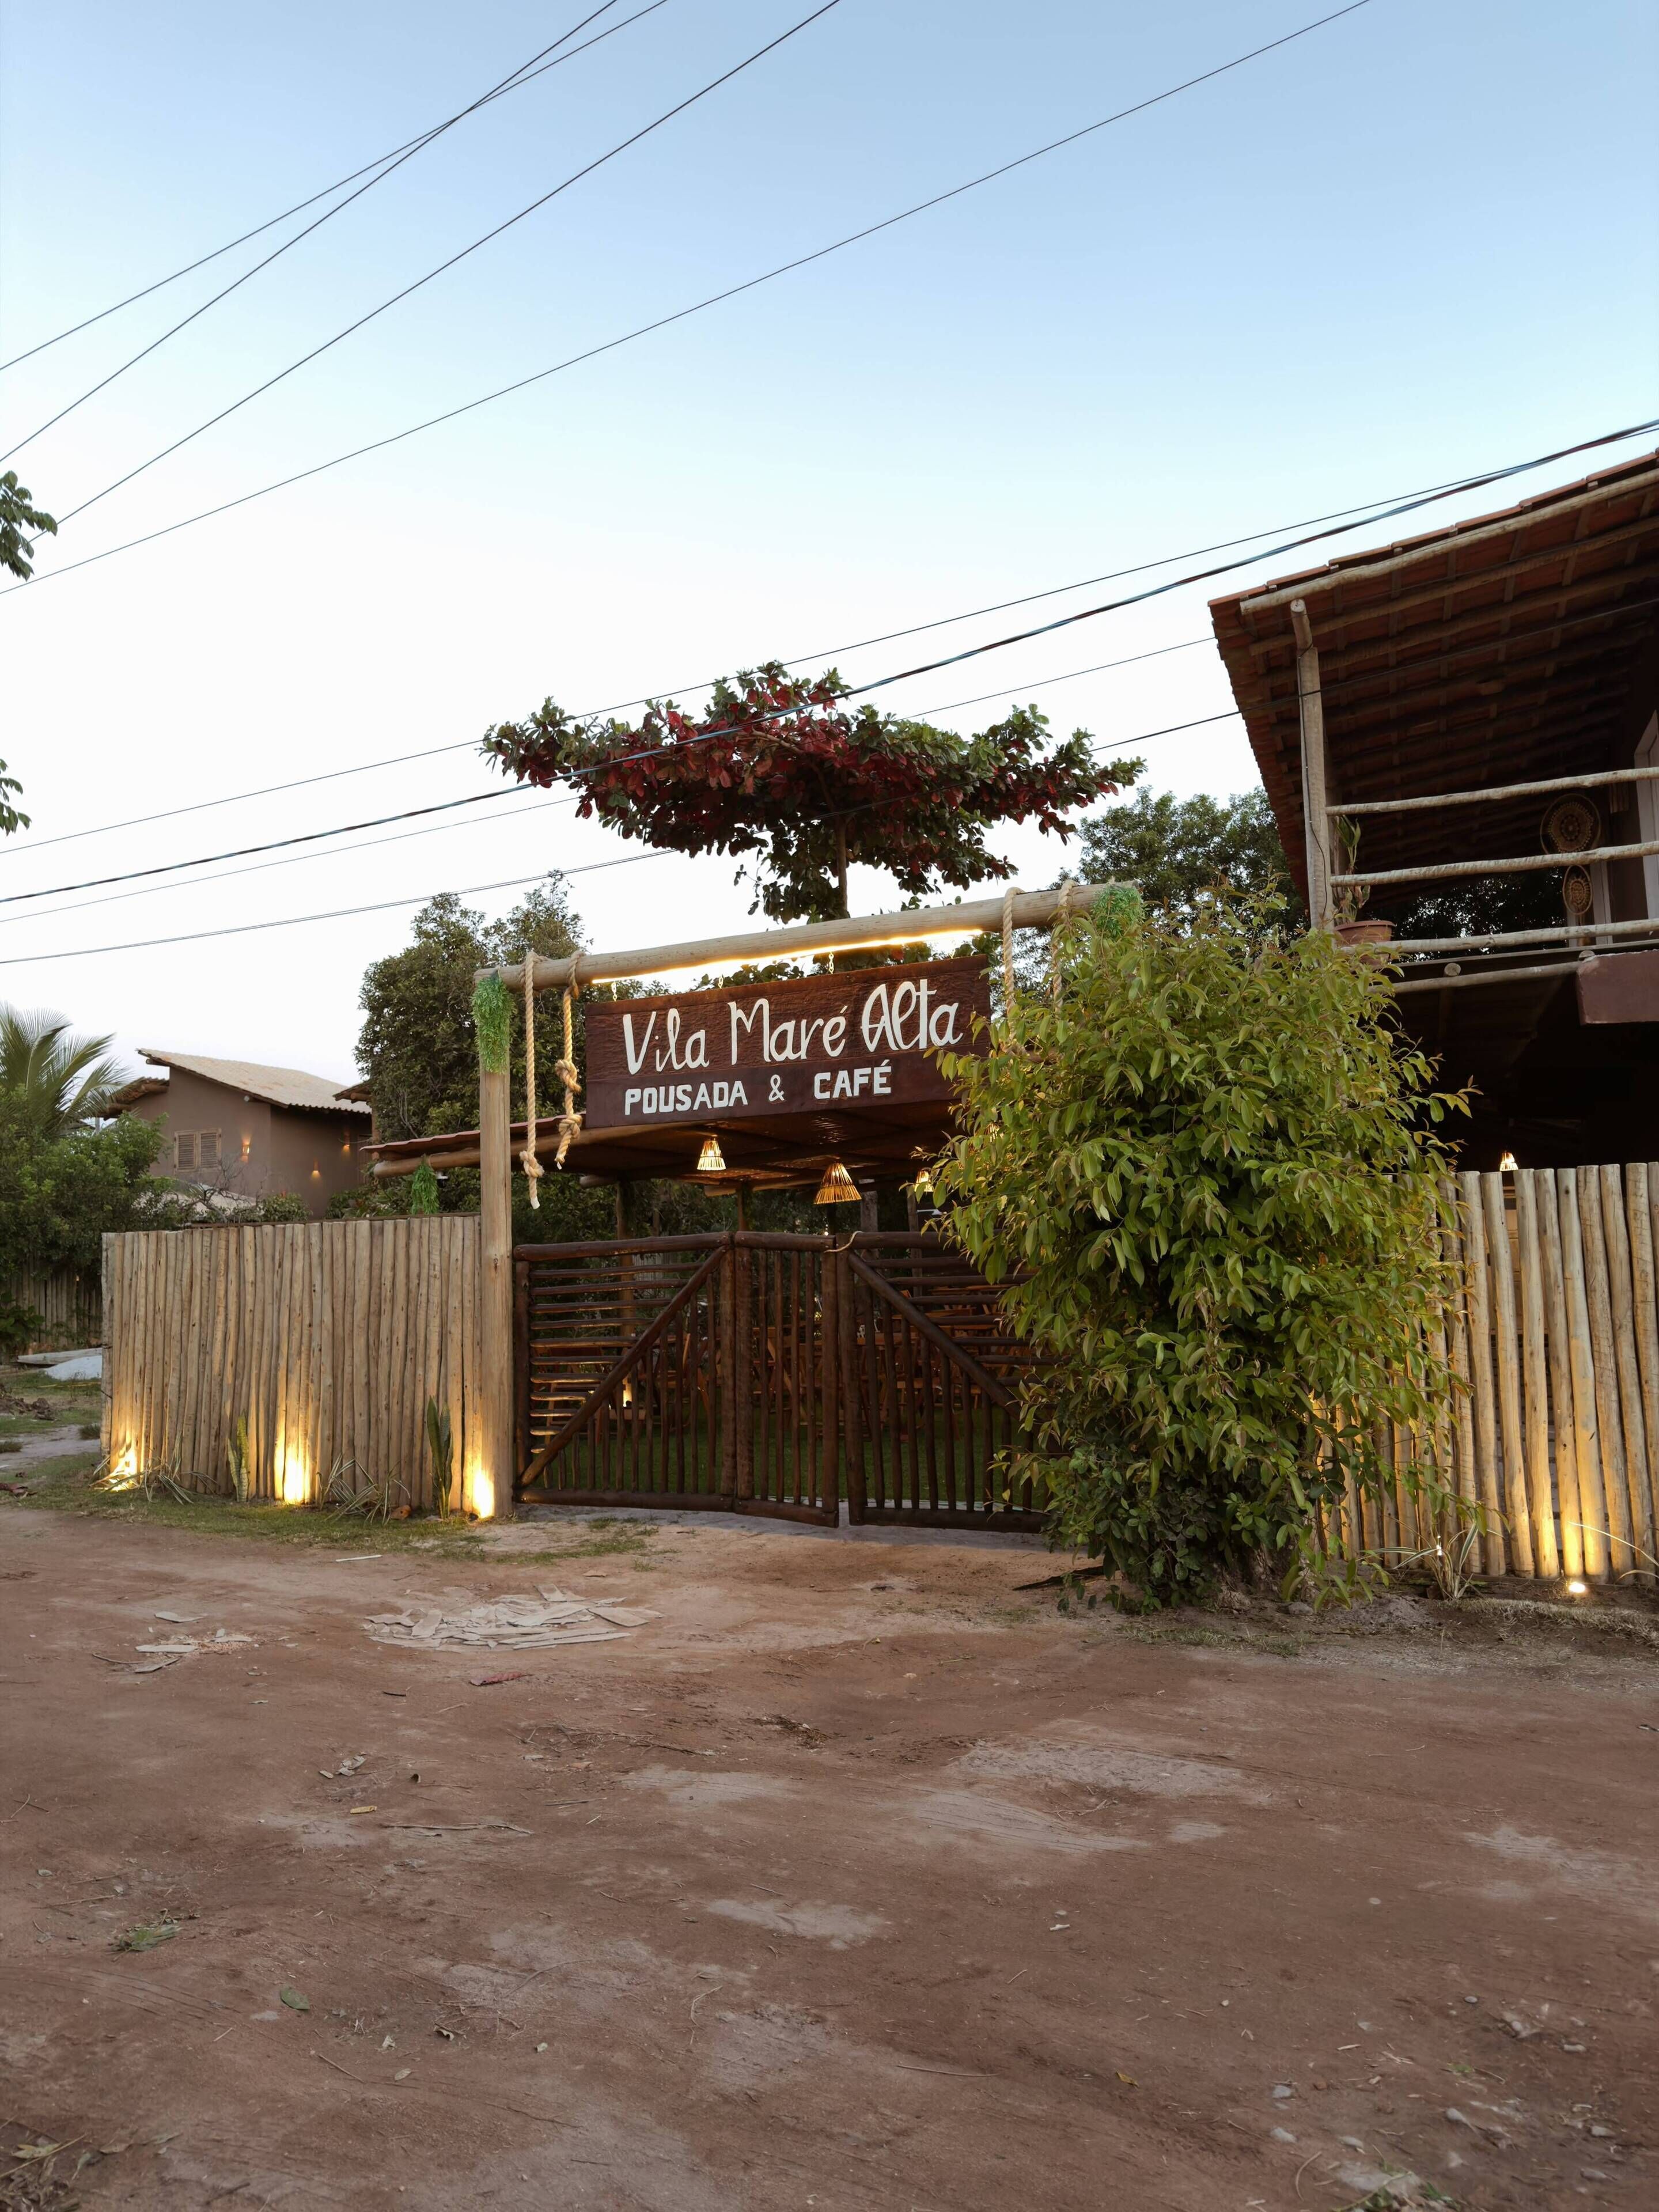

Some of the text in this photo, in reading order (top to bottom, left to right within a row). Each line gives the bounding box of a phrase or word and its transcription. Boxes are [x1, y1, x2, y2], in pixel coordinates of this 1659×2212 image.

[623, 979, 963, 1075] Vila Maré Alta
[625, 1059, 892, 1116] POUSADA & CAFÉ
